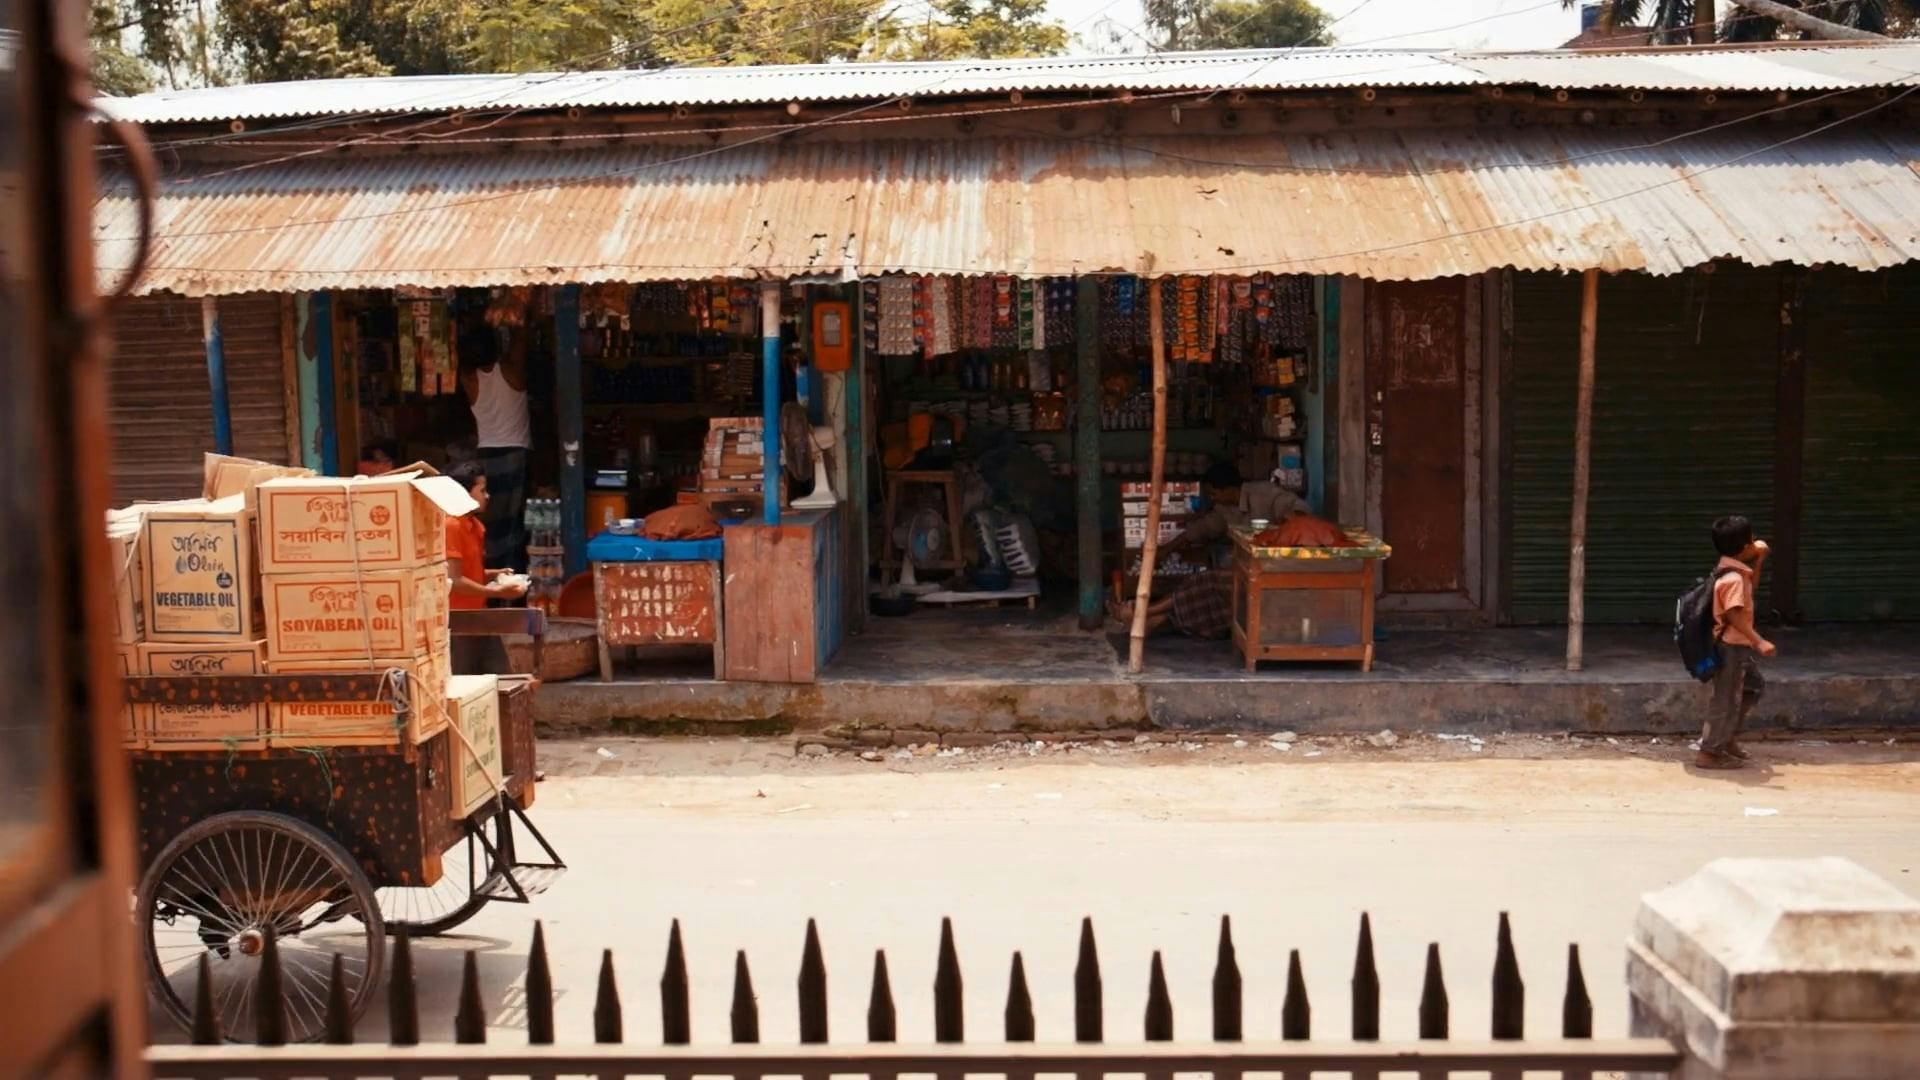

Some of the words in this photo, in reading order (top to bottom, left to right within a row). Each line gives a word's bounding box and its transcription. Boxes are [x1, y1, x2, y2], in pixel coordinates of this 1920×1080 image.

[279, 527, 345, 543] সয়াবিন
[355, 529, 393, 543] তেল
[156, 592, 216, 607] VEGETABLE
[218, 592, 236, 607] OIL
[282, 617, 365, 633] SOYABEAN
[372, 617, 398, 631] OIL
[289, 704, 369, 716] VEGETABLE
[372, 704, 395, 716] OIL
